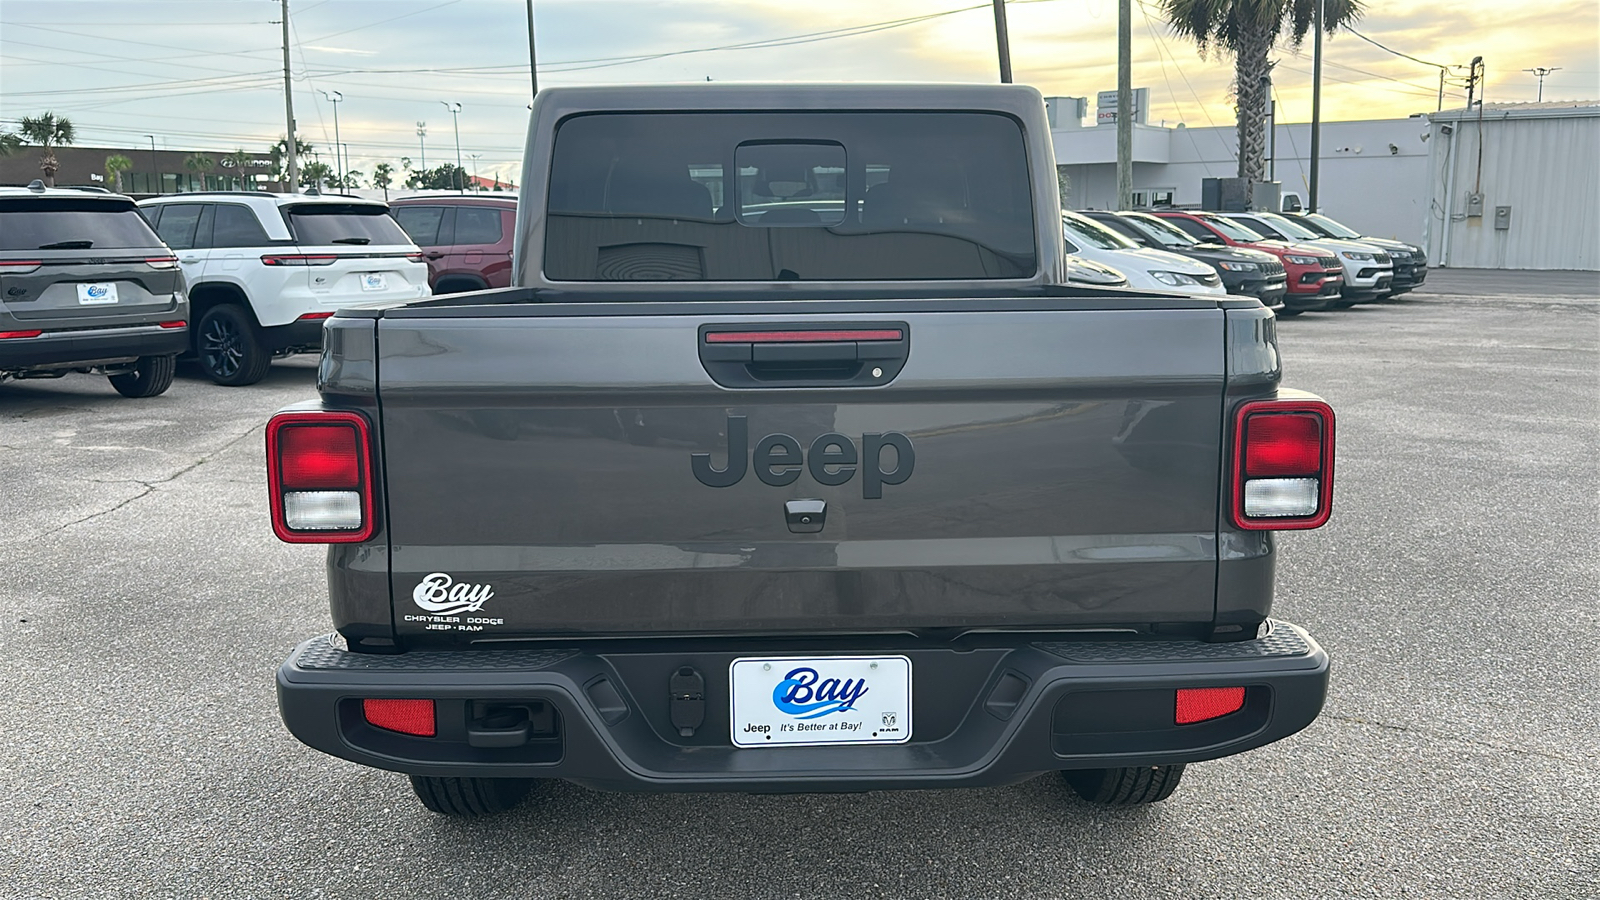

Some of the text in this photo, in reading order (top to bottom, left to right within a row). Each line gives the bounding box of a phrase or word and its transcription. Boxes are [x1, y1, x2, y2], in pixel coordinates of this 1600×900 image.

[90, 285, 108, 297] Bay
[691, 415, 916, 500] Jeep
[419, 572, 495, 613] Bay
[404, 614, 504, 626] CHRYSLER DODGE
[425, 623, 484, 632] JEEP RAM
[780, 666, 870, 713] Bay
[743, 722, 771, 734] Jeep
[780, 721, 863, 732] It's Better at Bay!
